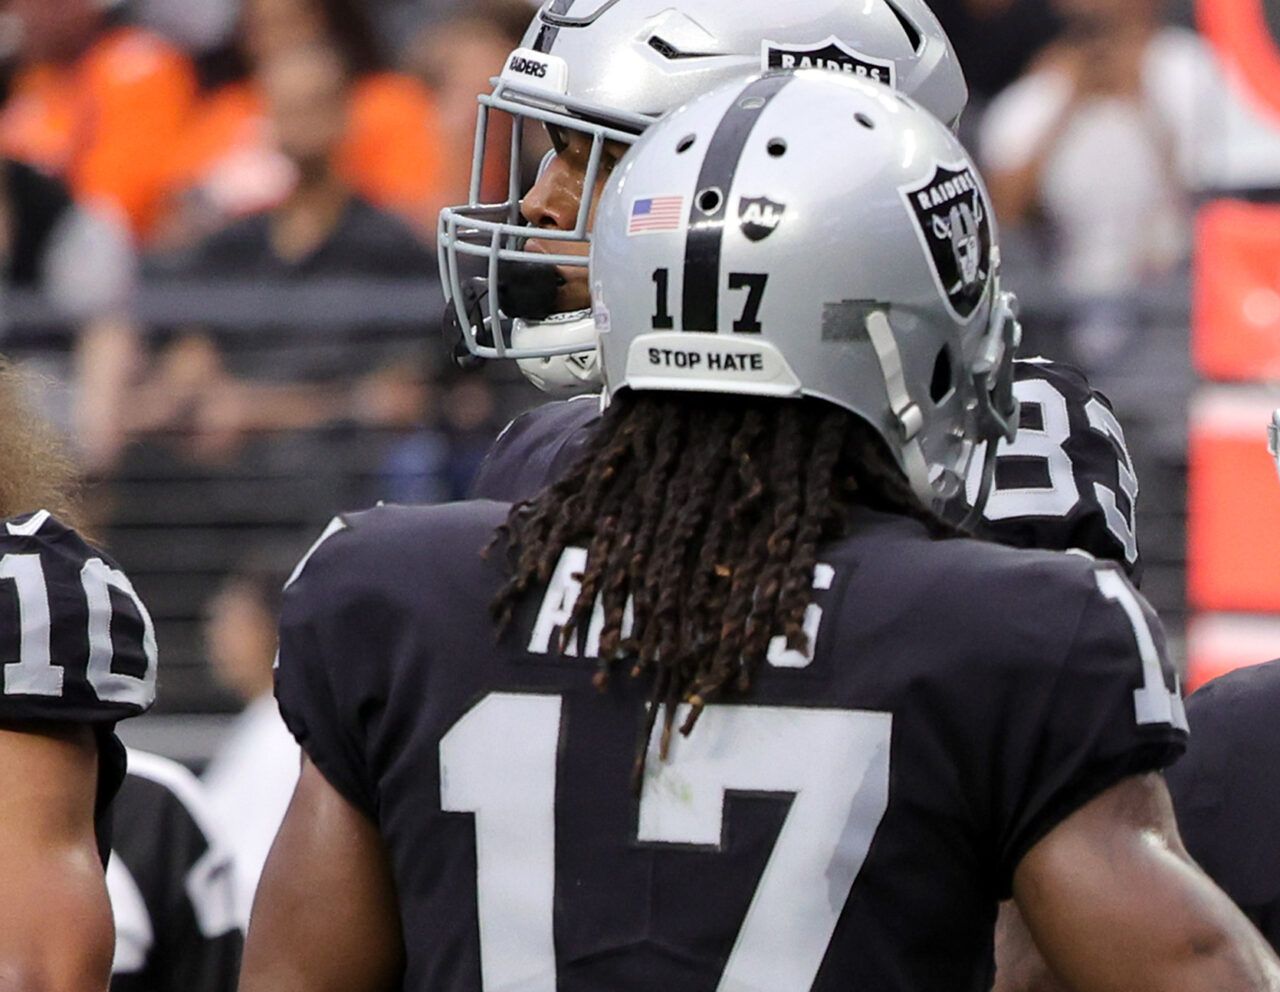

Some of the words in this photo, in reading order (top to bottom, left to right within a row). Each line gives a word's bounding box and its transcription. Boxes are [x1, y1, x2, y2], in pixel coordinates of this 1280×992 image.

[648, 348, 701, 369] STOP
[708, 353, 764, 370] HATE
[0, 553, 158, 710] 10
[1095, 569, 1190, 733] 1
